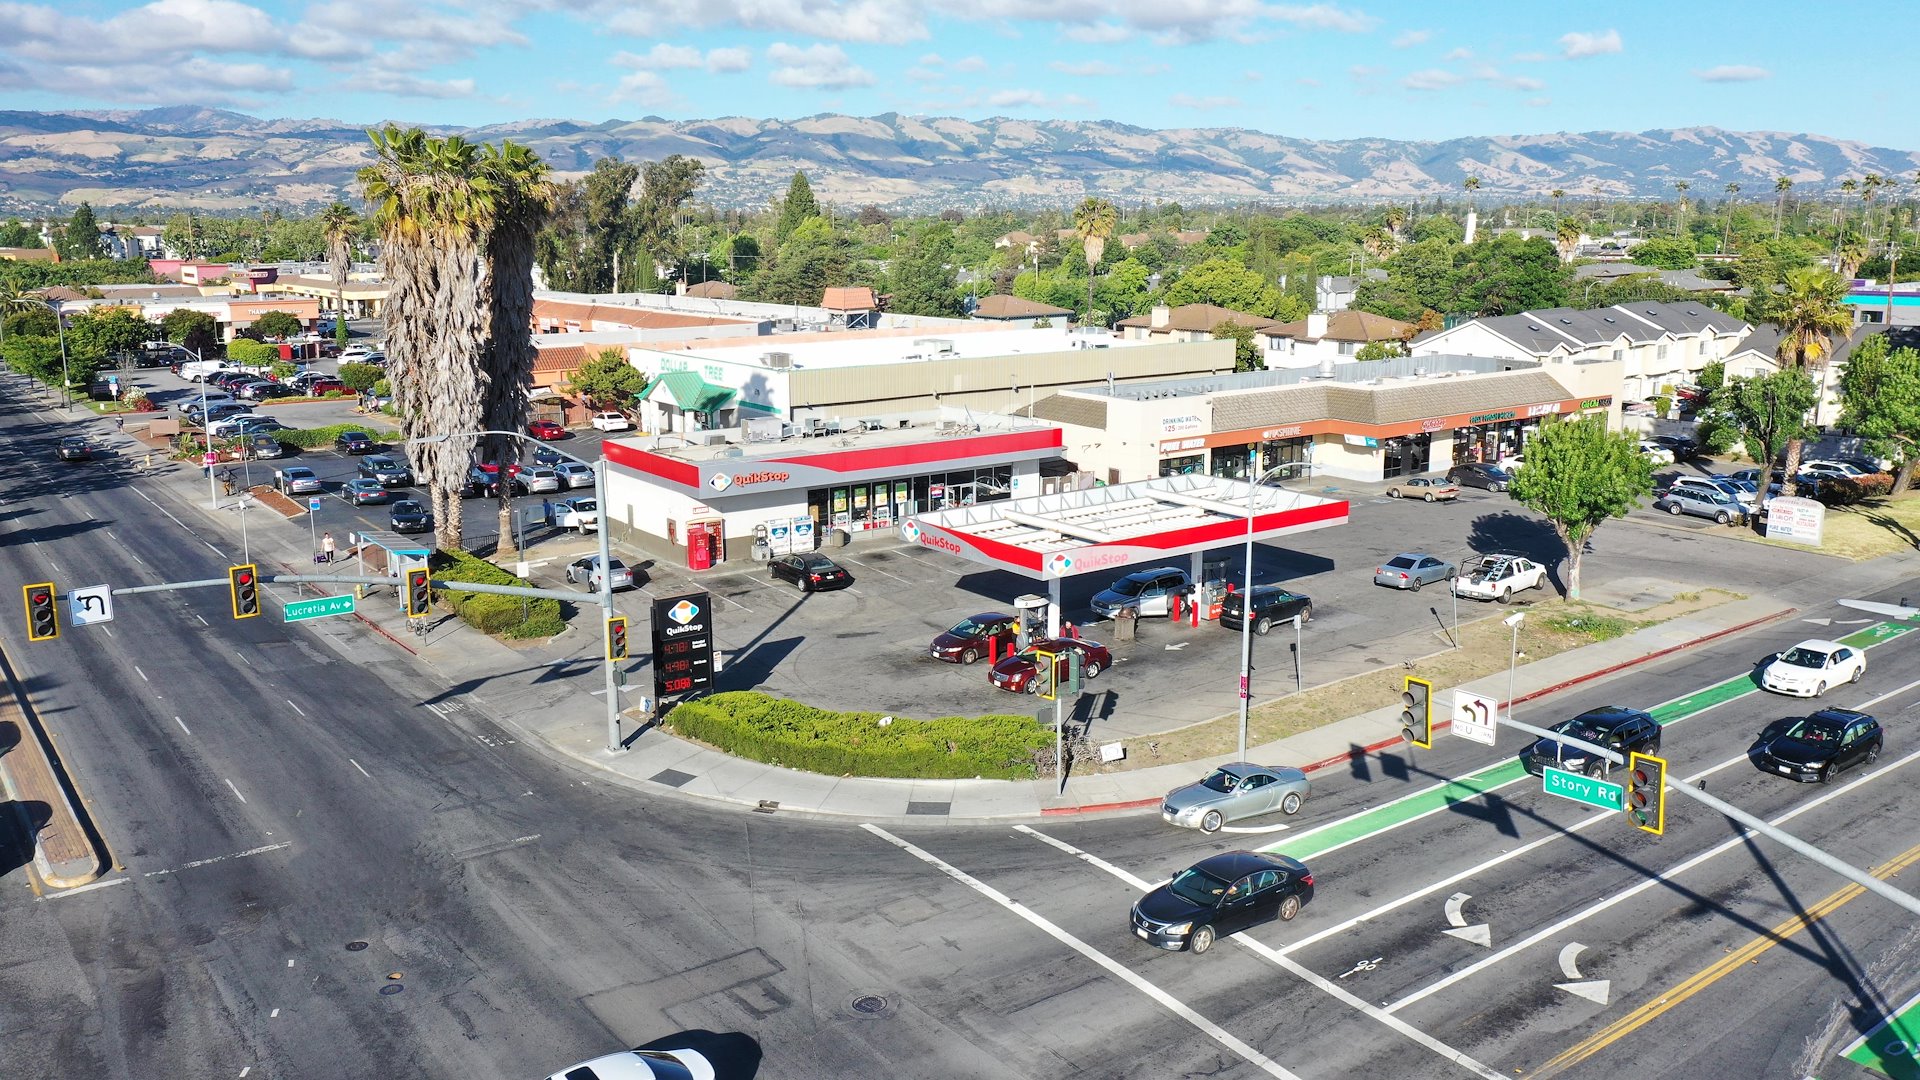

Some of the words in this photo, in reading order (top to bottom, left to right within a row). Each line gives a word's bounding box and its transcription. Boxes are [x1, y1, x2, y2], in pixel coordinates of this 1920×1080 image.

[660, 357, 688, 372] DOLLAR
[704, 364, 724, 381] TREE
[733, 471, 790, 488] QuikStop
[920, 532, 961, 555] QuikStop
[1074, 553, 1129, 572] QuikStop
[286, 604, 326, 617] Lucretia
[330, 602, 342, 610] Av
[666, 624, 703, 636] QuikStop
[1551, 774, 1591, 797] Story
[1597, 786, 1617, 802] Rd
